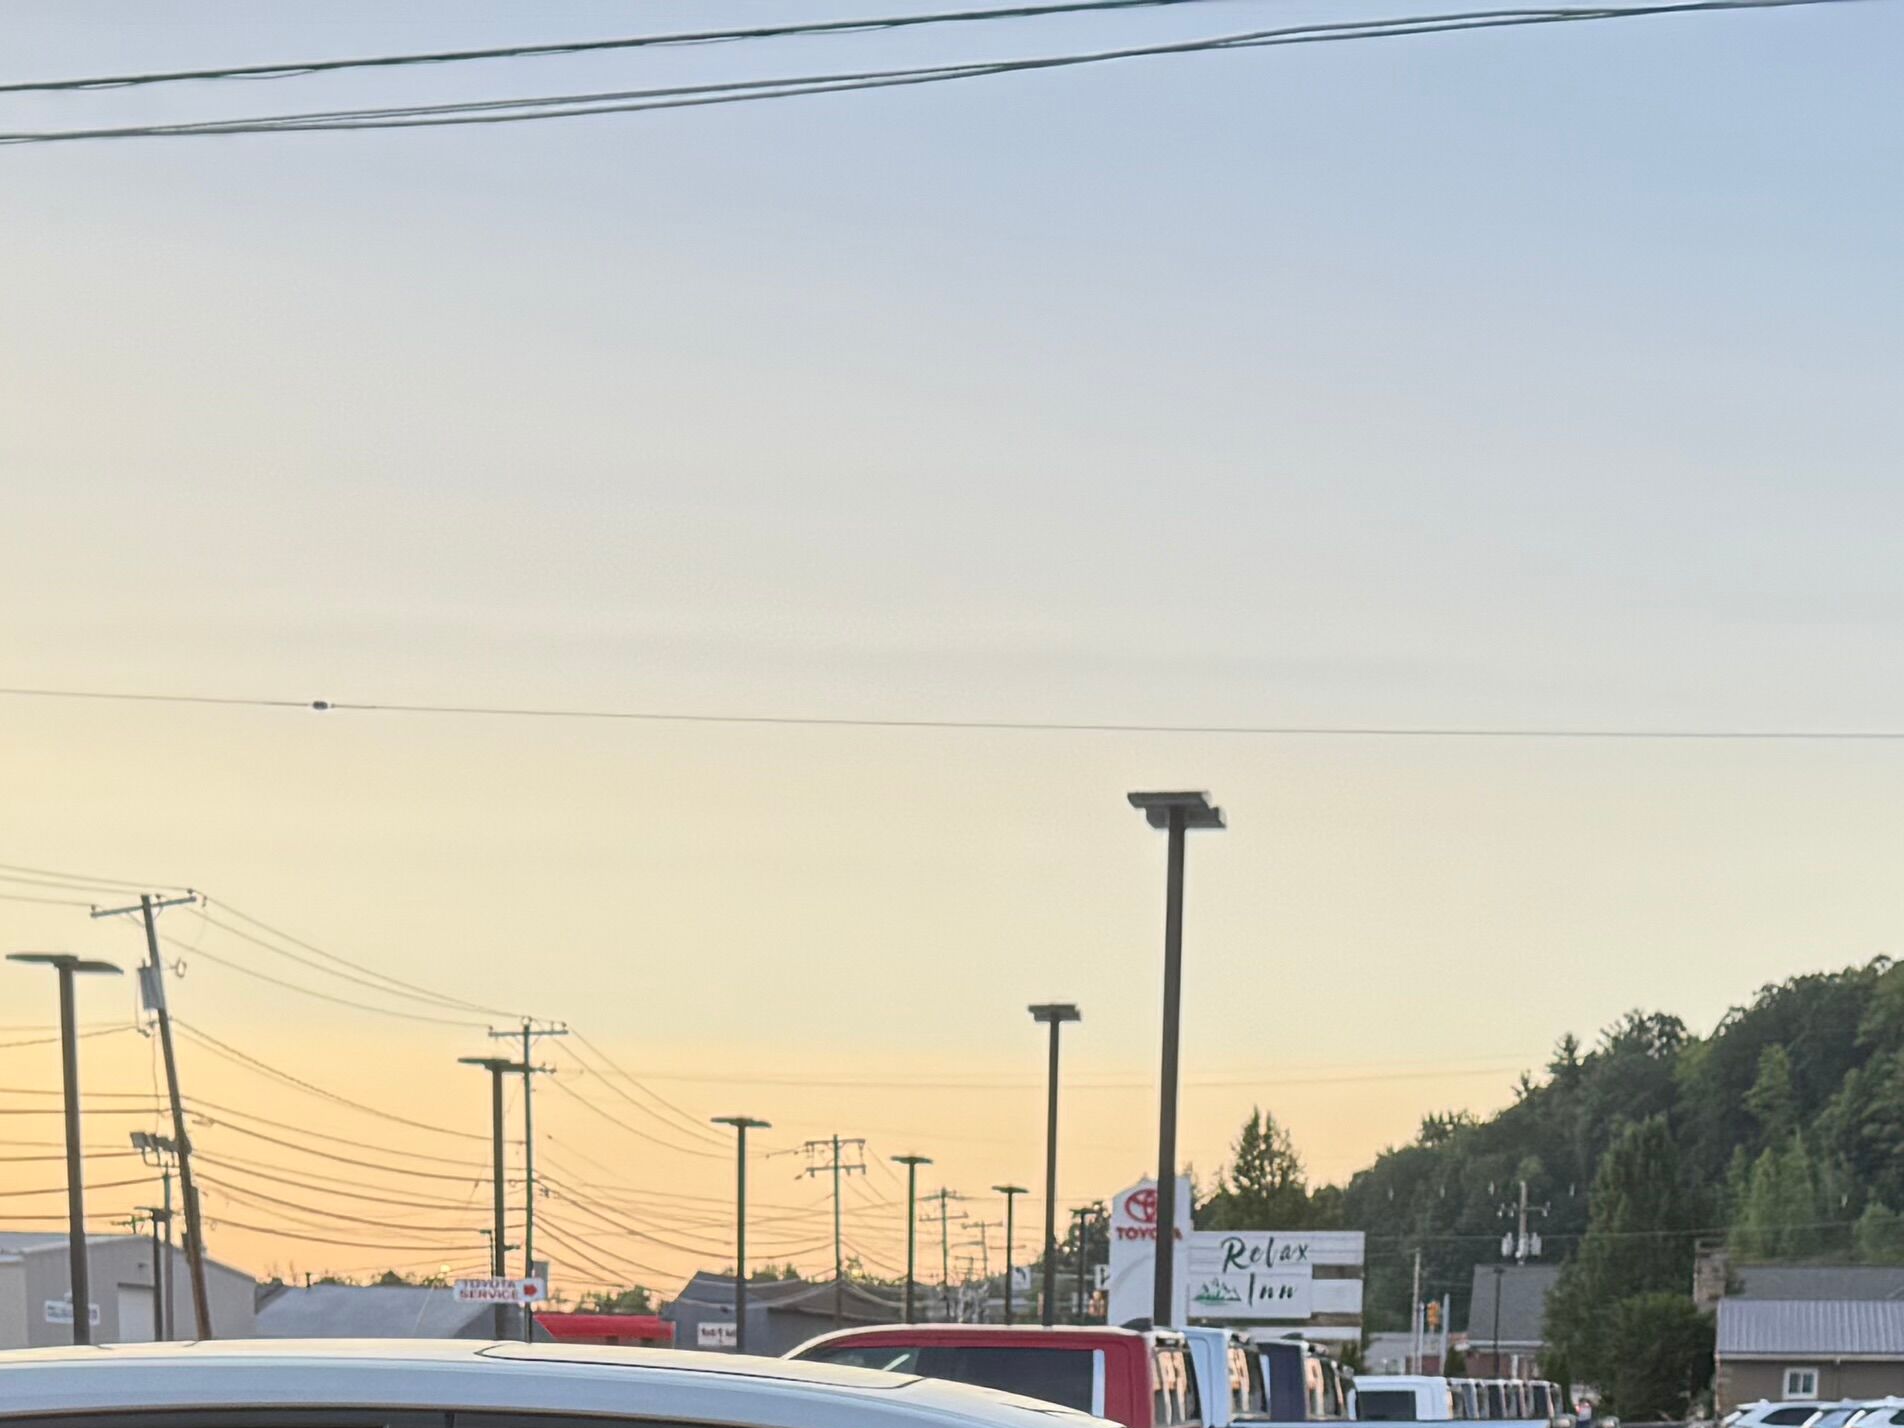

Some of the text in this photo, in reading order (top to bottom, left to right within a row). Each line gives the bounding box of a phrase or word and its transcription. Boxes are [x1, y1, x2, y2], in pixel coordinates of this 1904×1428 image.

[1221, 1236, 1309, 1273] Relax
[460, 1289, 518, 1299] SERVICE
[1248, 1272, 1296, 1308] Inn
